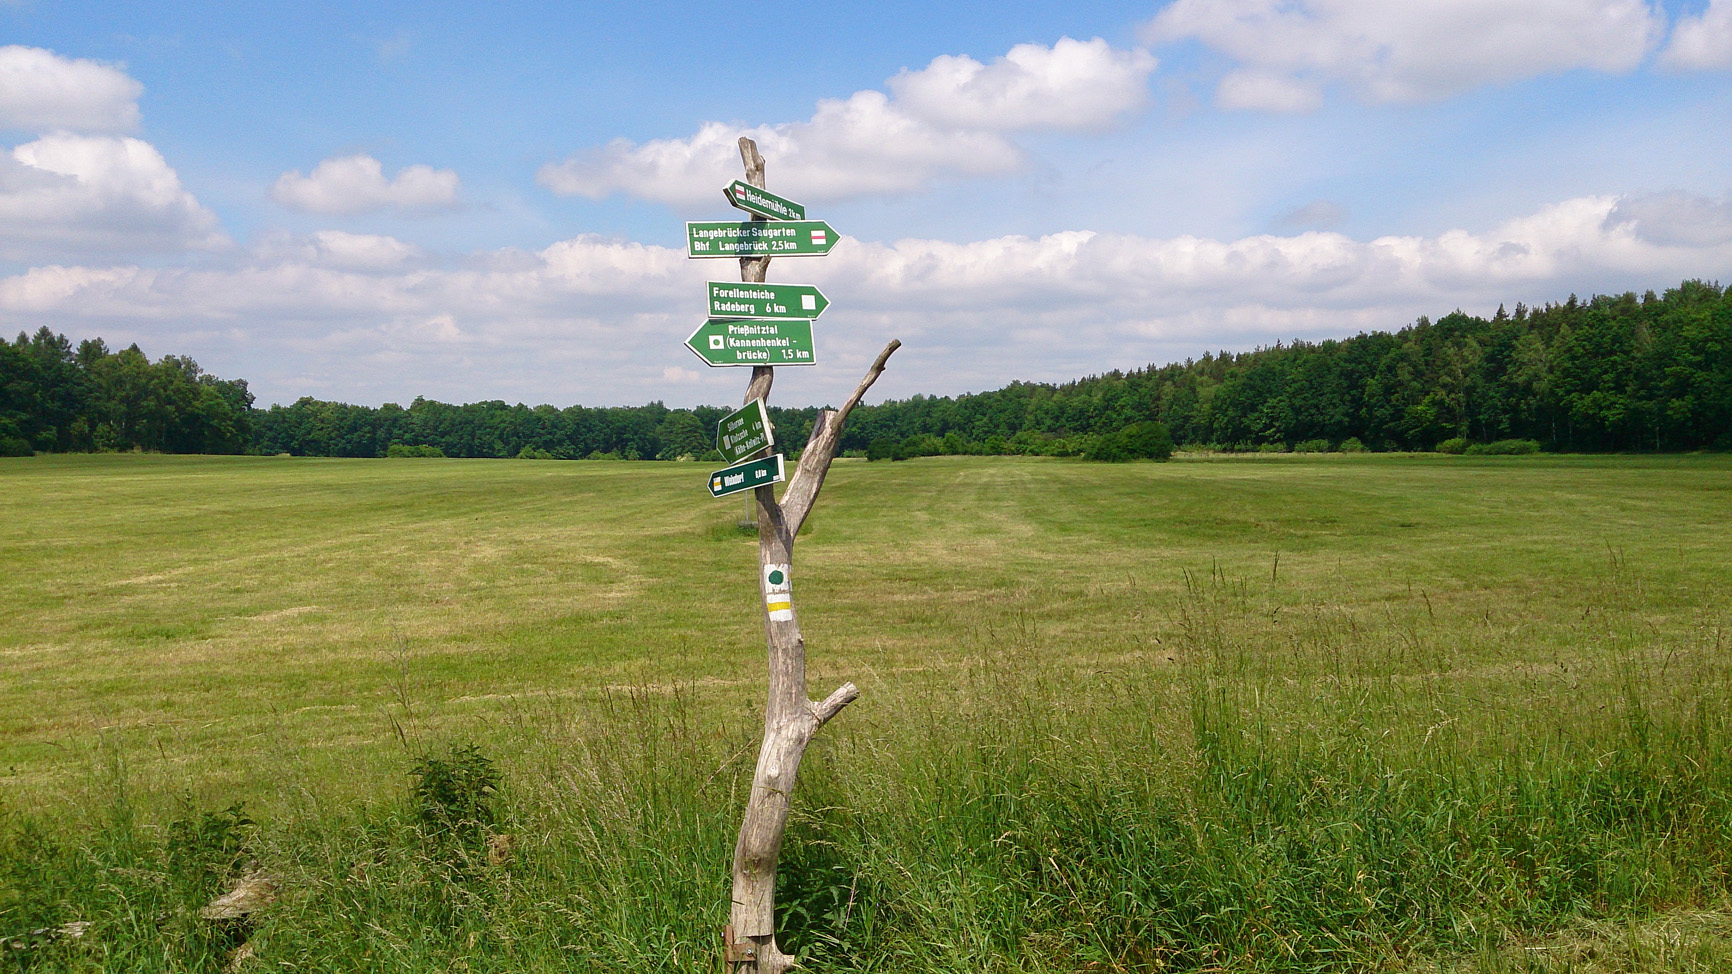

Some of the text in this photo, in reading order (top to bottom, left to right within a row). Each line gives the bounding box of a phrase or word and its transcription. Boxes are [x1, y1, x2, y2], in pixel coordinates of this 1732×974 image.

[746, 188, 788, 216] Heidemühle
[692, 227, 797, 240] Langebrücker Saugarten
[718, 240, 769, 252] Langebrück
[783, 240, 798, 250] km
[712, 286, 776, 300] Forellenteiche
[713, 300, 787, 315] Radeberg 6 km
[728, 324, 779, 337] Prießnitztal
[736, 347, 770, 362] brücke)
[781, 348, 794, 360] 1,5
[795, 348, 810, 359] km
